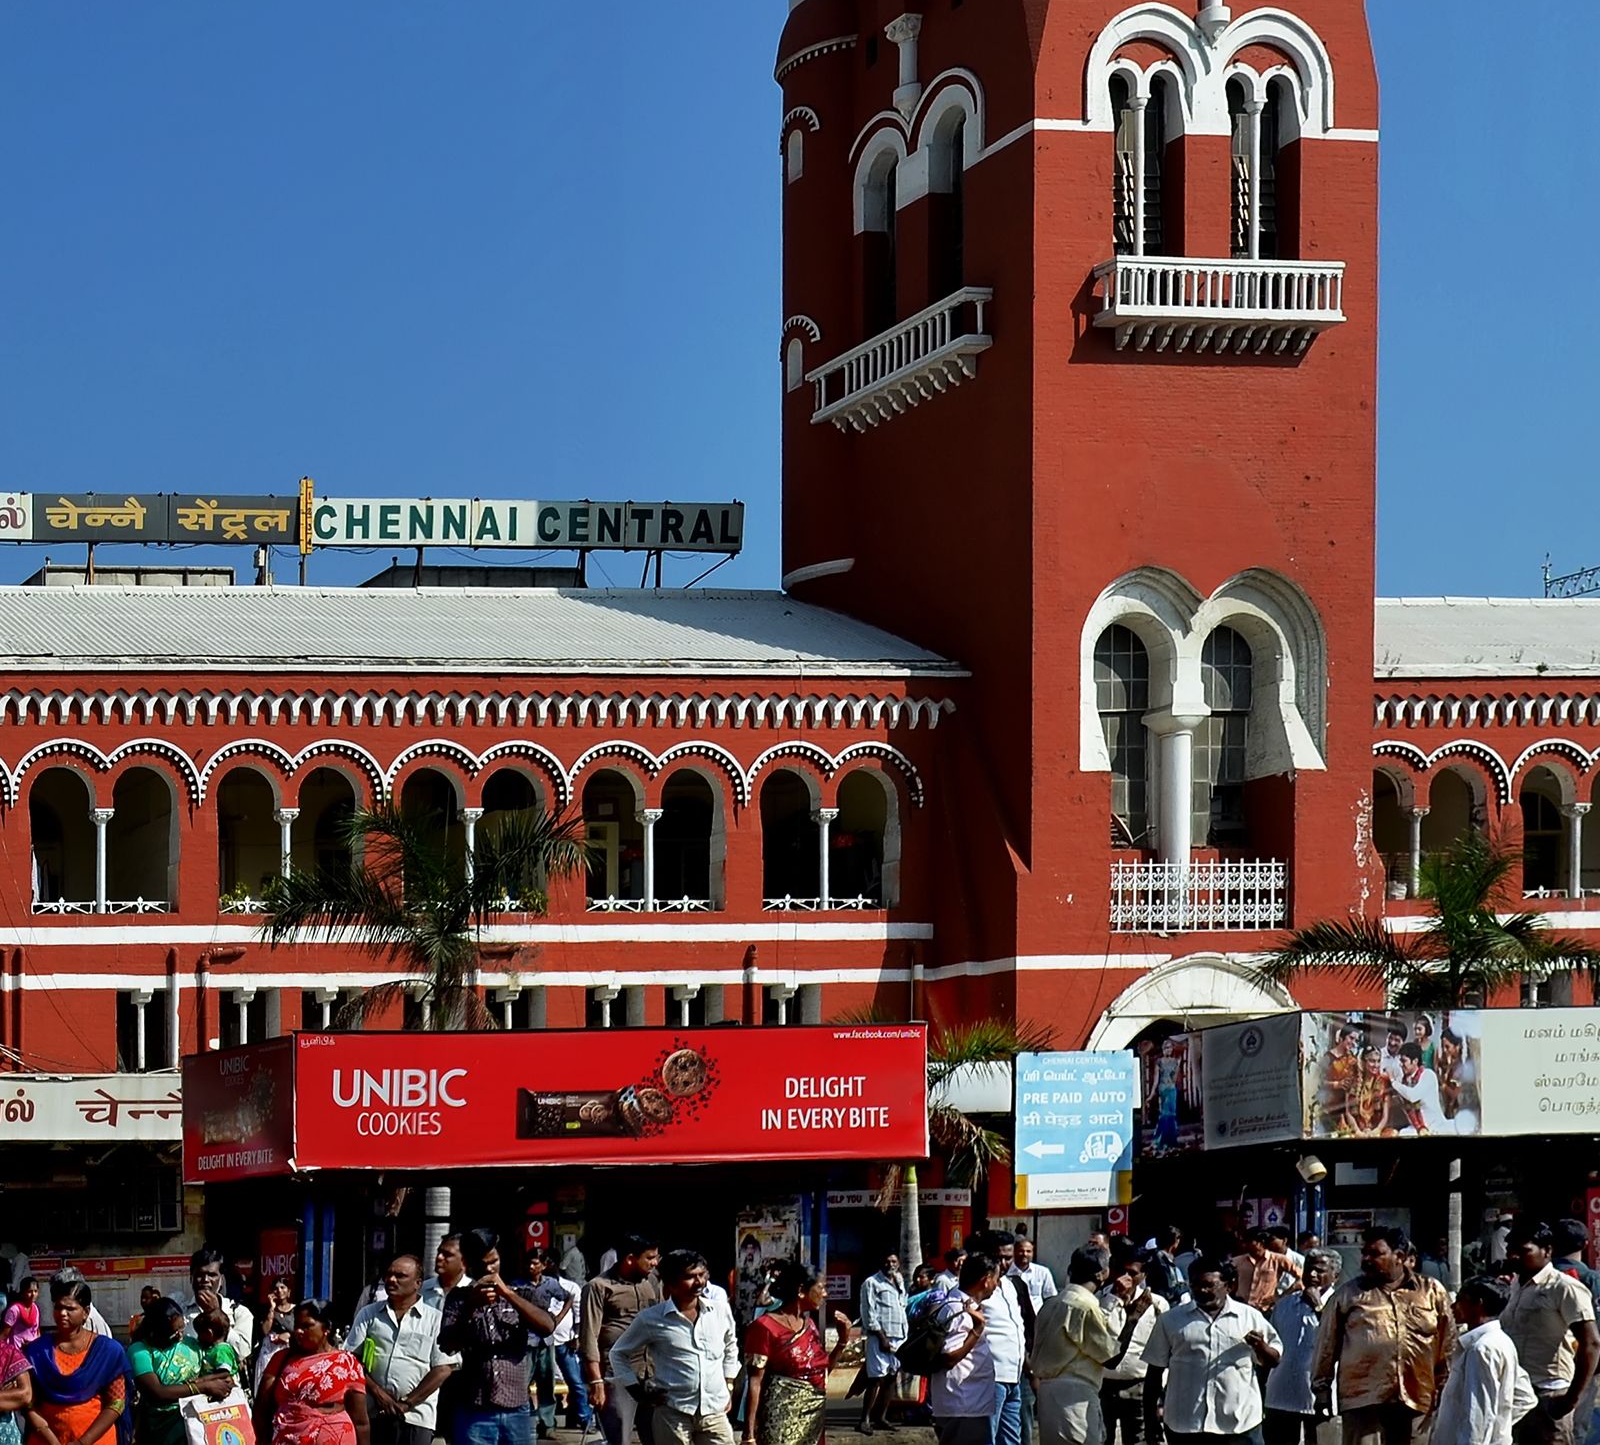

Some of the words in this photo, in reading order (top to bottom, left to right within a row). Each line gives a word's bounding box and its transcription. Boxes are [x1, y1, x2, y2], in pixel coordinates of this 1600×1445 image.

[46, 496, 147, 530] चेन्नै
[176, 498, 291, 540] सेंट्रल
[313, 504, 518, 541] CHENNAI
[537, 507, 741, 544] CENTRAL
[833, 1029, 920, 1039] www.facebook.com/unibic
[1524, 1024, 1565, 1039] மனம்
[220, 1055, 249, 1075] UNIBIC
[1042, 1057, 1073, 1065] CHENNAI
[1074, 1056, 1108, 1064] CENTRAL
[332, 1069, 467, 1107] UNIBIC
[786, 1076, 866, 1098] DELIGHT
[1023, 1092, 1049, 1104] PRE
[1053, 1092, 1082, 1103] PAID
[1090, 1091, 1126, 1103] AUTO
[357, 1111, 441, 1136] COOKIES
[761, 1109, 781, 1130] IN
[788, 1107, 847, 1129] EVERY
[850, 1106, 890, 1128] BITE
[198, 1155, 224, 1170] DELIGHT
[227, 1153, 234, 1167] IN
[235, 1151, 257, 1166] EVERY
[258, 1149, 273, 1164] BITE
[846, 1195, 862, 1204] YOU
[260, 1254, 296, 1276] UNIBIC
